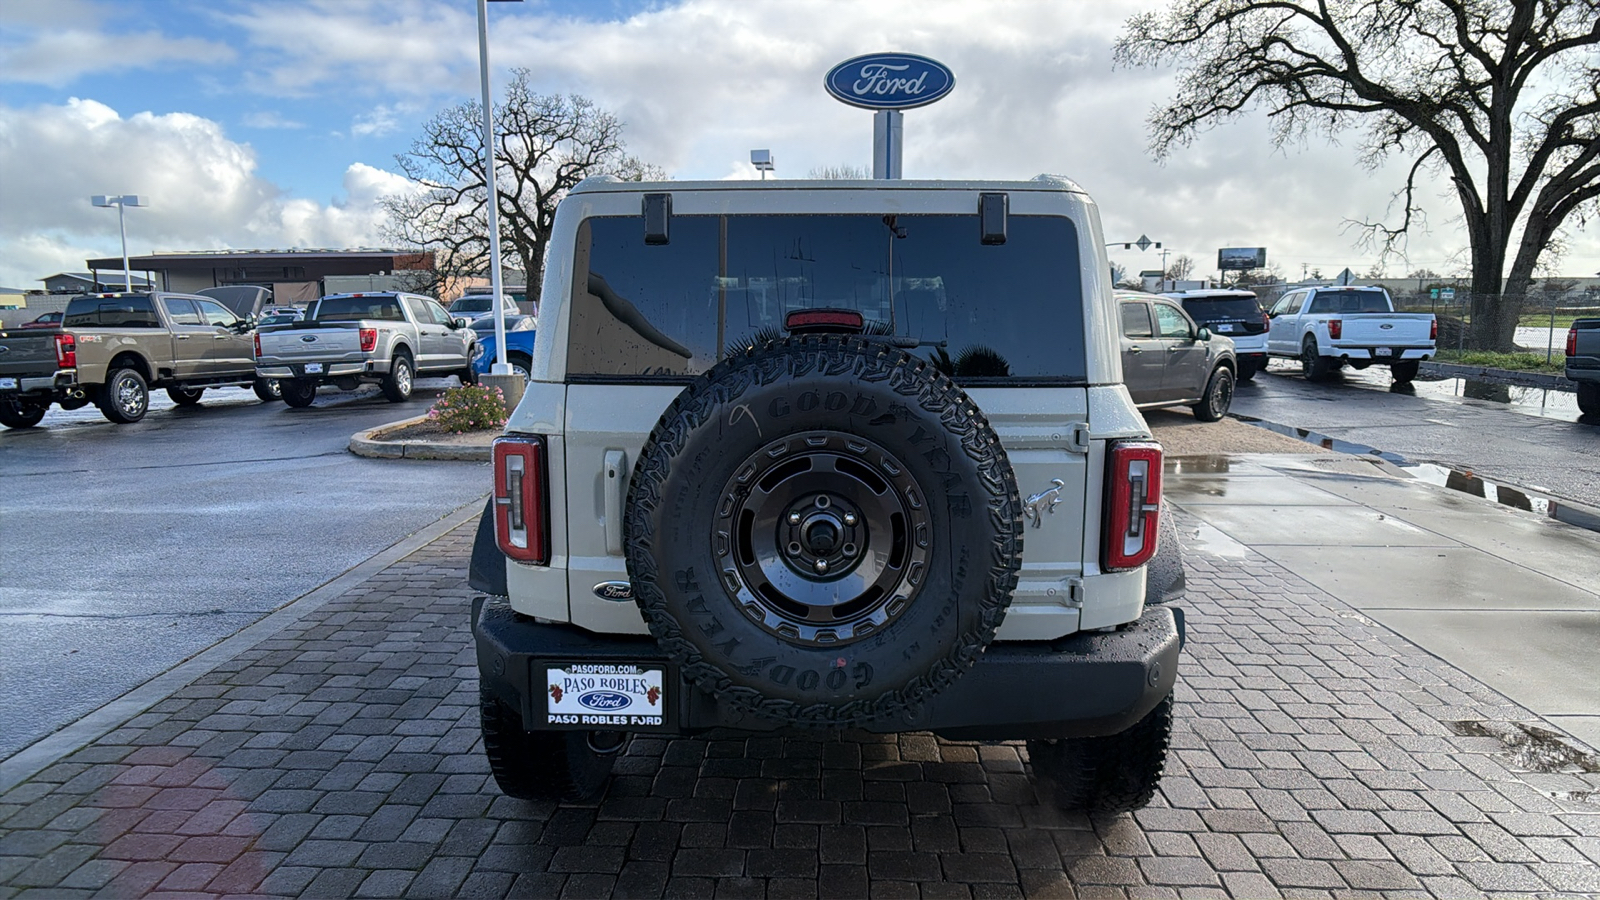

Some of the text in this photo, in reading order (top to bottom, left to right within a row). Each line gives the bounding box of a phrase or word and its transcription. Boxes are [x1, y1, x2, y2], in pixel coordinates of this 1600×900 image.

[853, 63, 928, 95] Ford
[603, 585, 632, 598] Ford
[571, 665, 637, 674] PASOFORD.COM
[563, 677, 648, 695] PASO ROBLES
[589, 694, 622, 707] Ford
[548, 715, 662, 726] PASO ROBLES FORD
